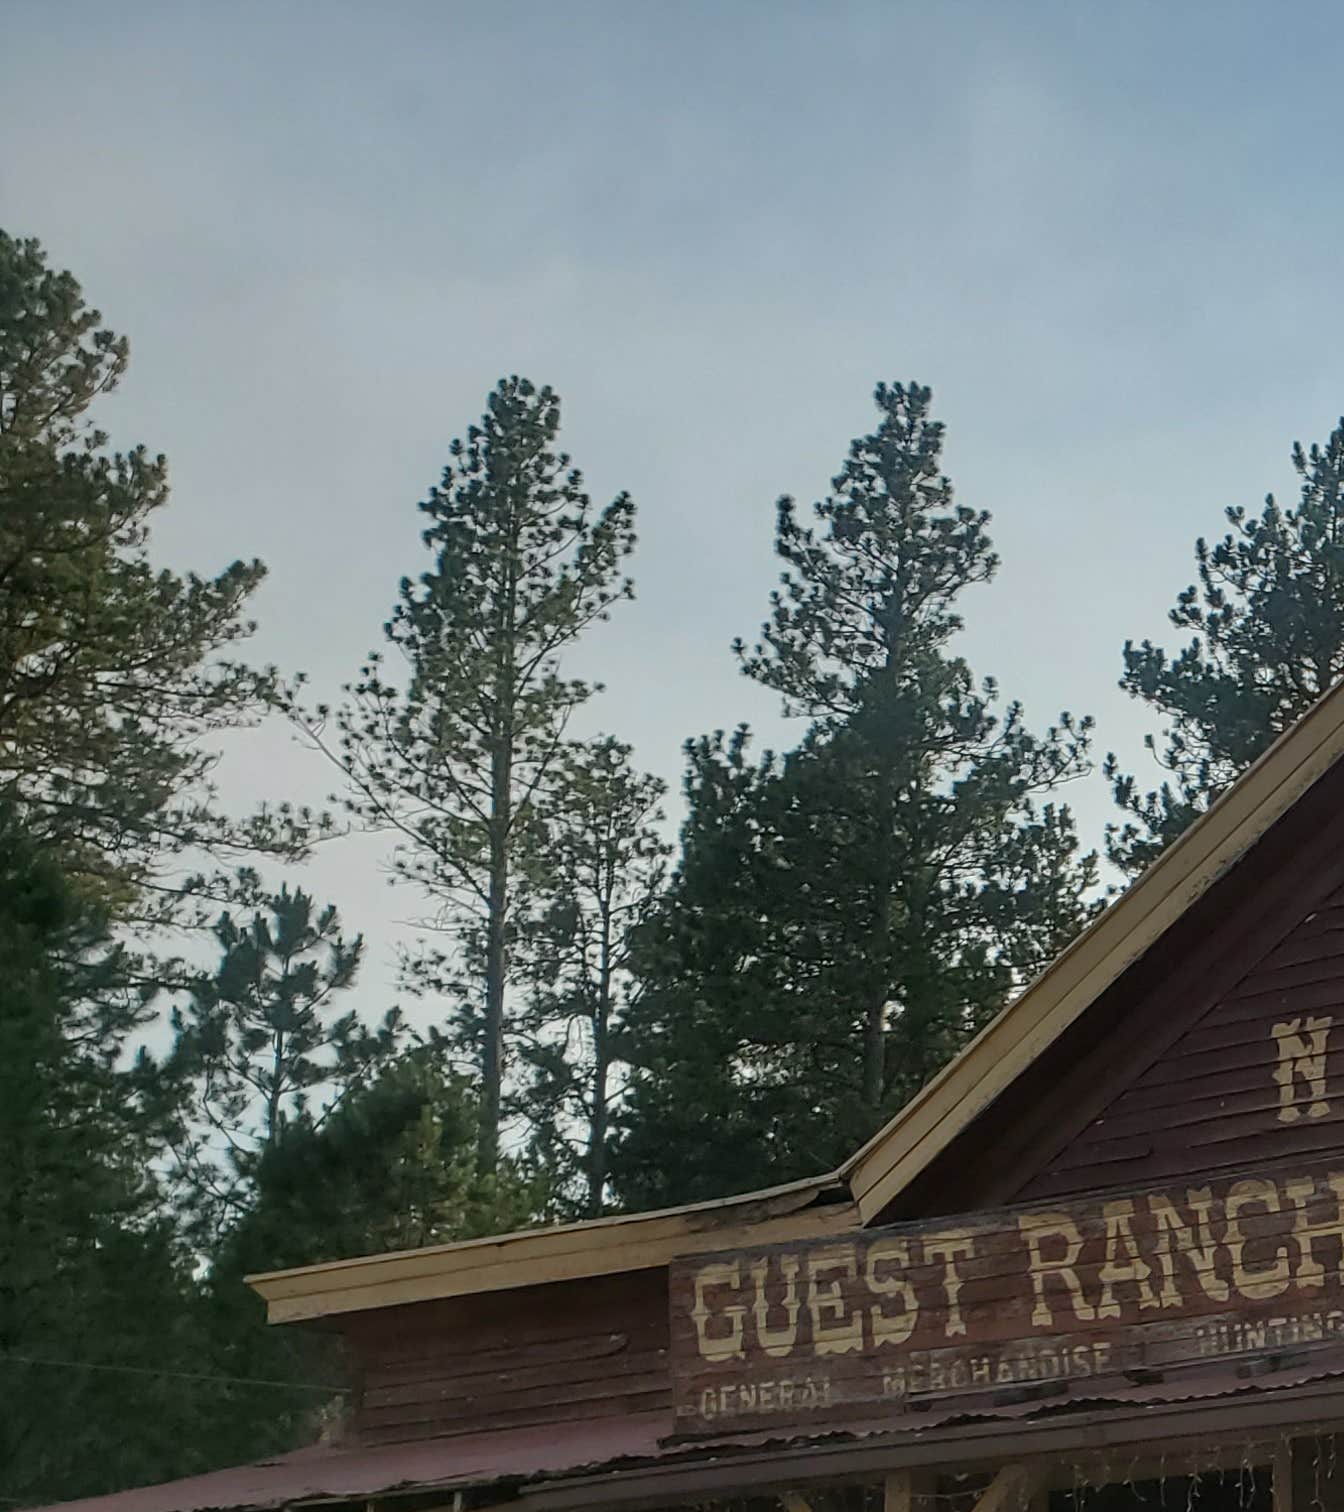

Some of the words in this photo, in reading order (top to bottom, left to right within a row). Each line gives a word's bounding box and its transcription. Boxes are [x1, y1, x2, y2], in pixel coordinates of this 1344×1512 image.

[692, 1229, 977, 1361] GUEST
[700, 1376, 833, 1421] GENERAL
[883, 1341, 1111, 1395] MERCHANDISE
